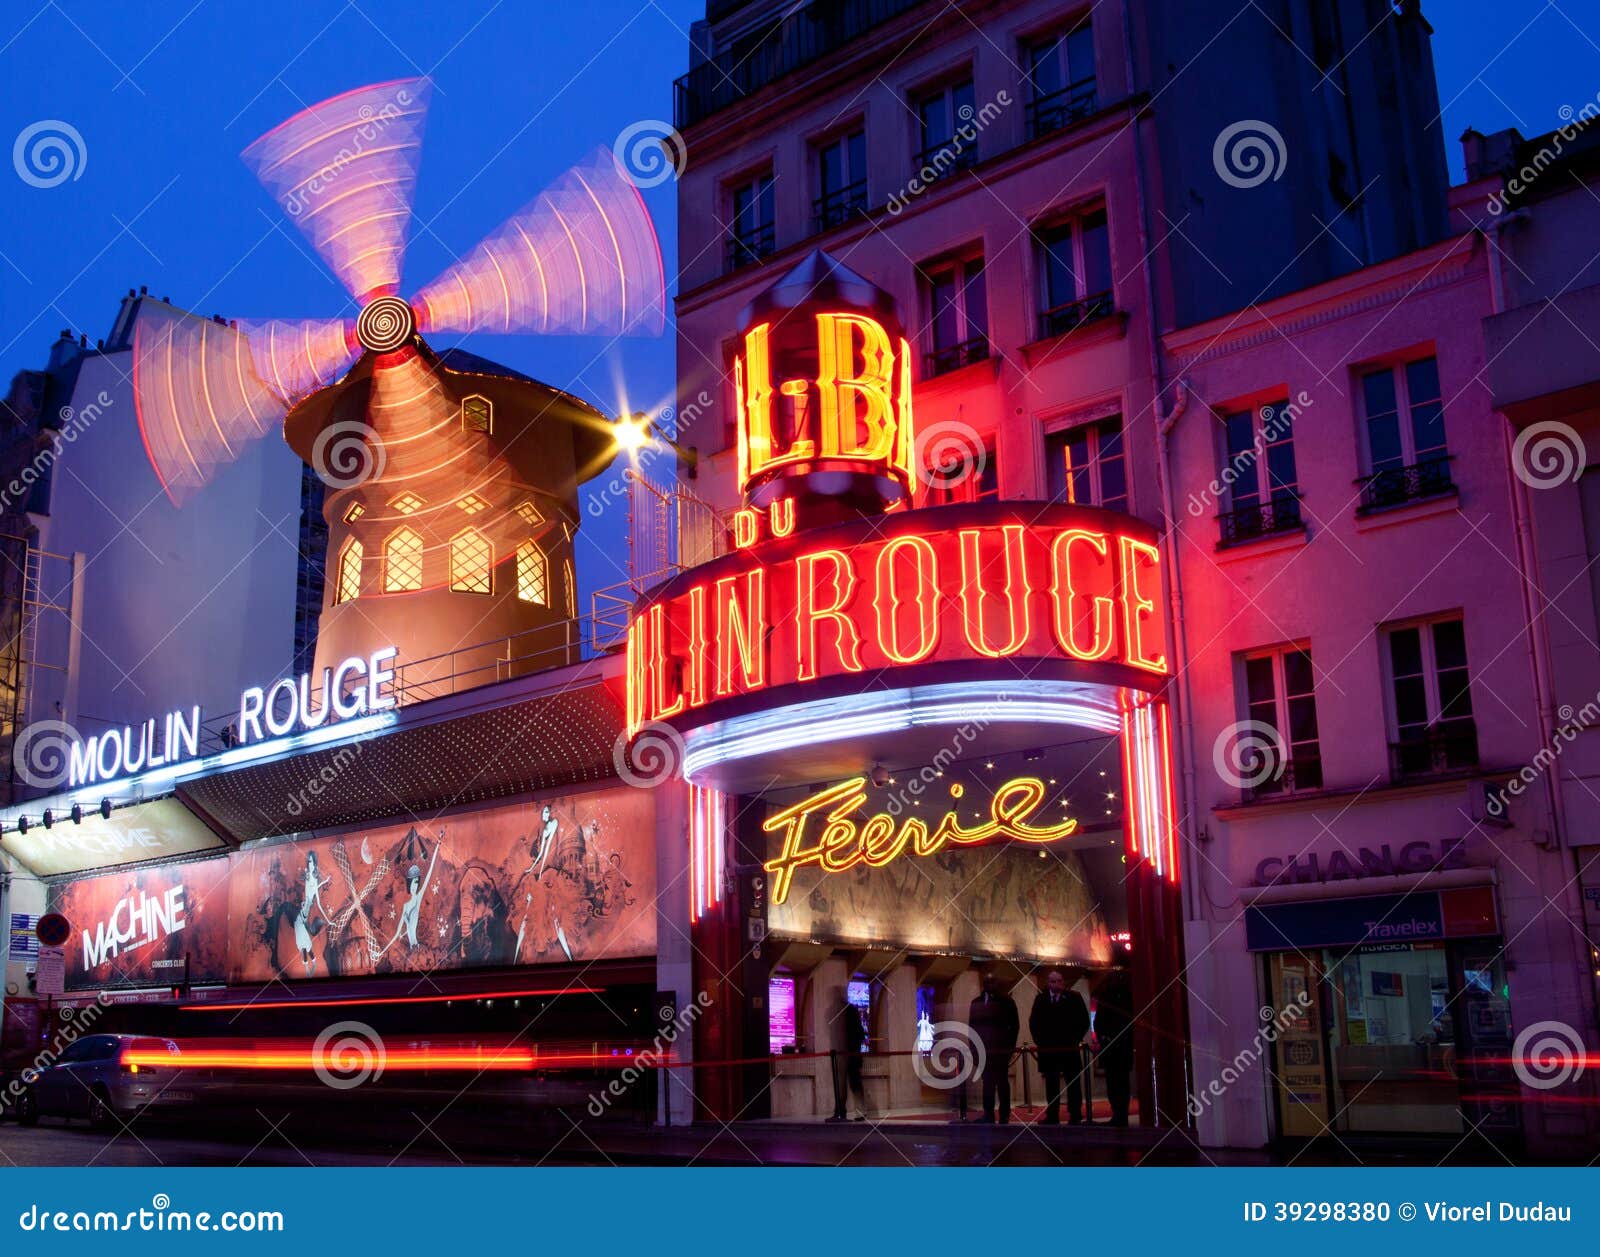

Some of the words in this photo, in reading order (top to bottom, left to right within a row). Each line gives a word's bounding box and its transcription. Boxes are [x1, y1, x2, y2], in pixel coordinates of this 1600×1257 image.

[734, 497, 796, 548] DU
[795, 525, 1169, 681] ROUGE
[69, 705, 199, 787] MOULIN
[239, 647, 397, 743] ROUGE
[1254, 837, 1468, 886] CHANGE
[82, 884, 187, 971] MACHINE
[1363, 918, 1438, 937] Travelex
